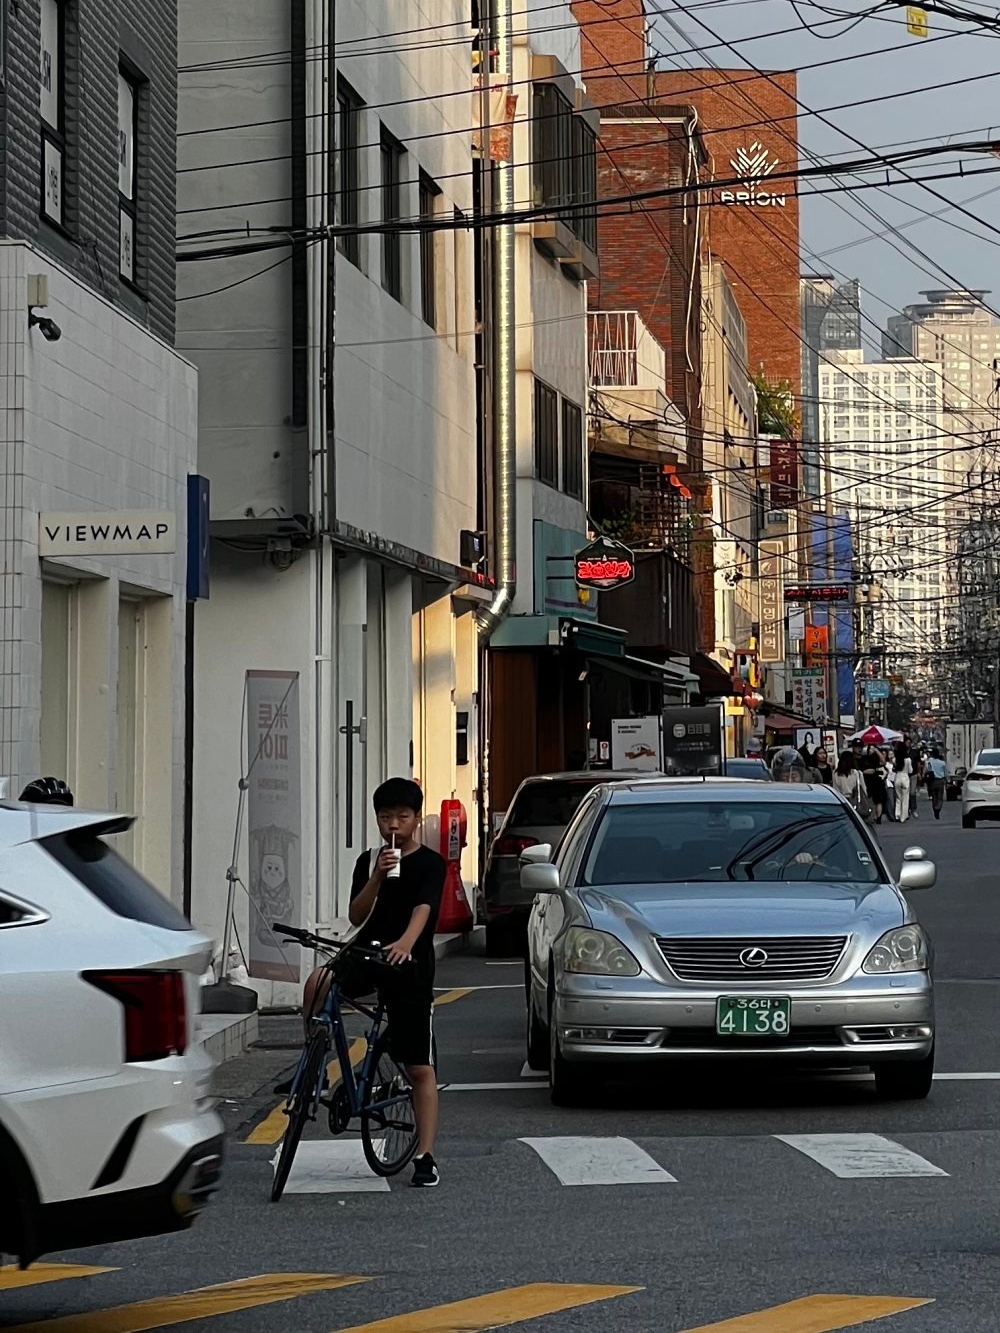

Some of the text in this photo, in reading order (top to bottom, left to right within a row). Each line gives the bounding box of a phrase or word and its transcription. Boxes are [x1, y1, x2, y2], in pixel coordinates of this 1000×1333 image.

[720, 191, 786, 207] BRION
[45, 522, 169, 543] VIEWMAP
[737, 999, 772, 1009] 36다
[720, 1010, 787, 1032] 4138
